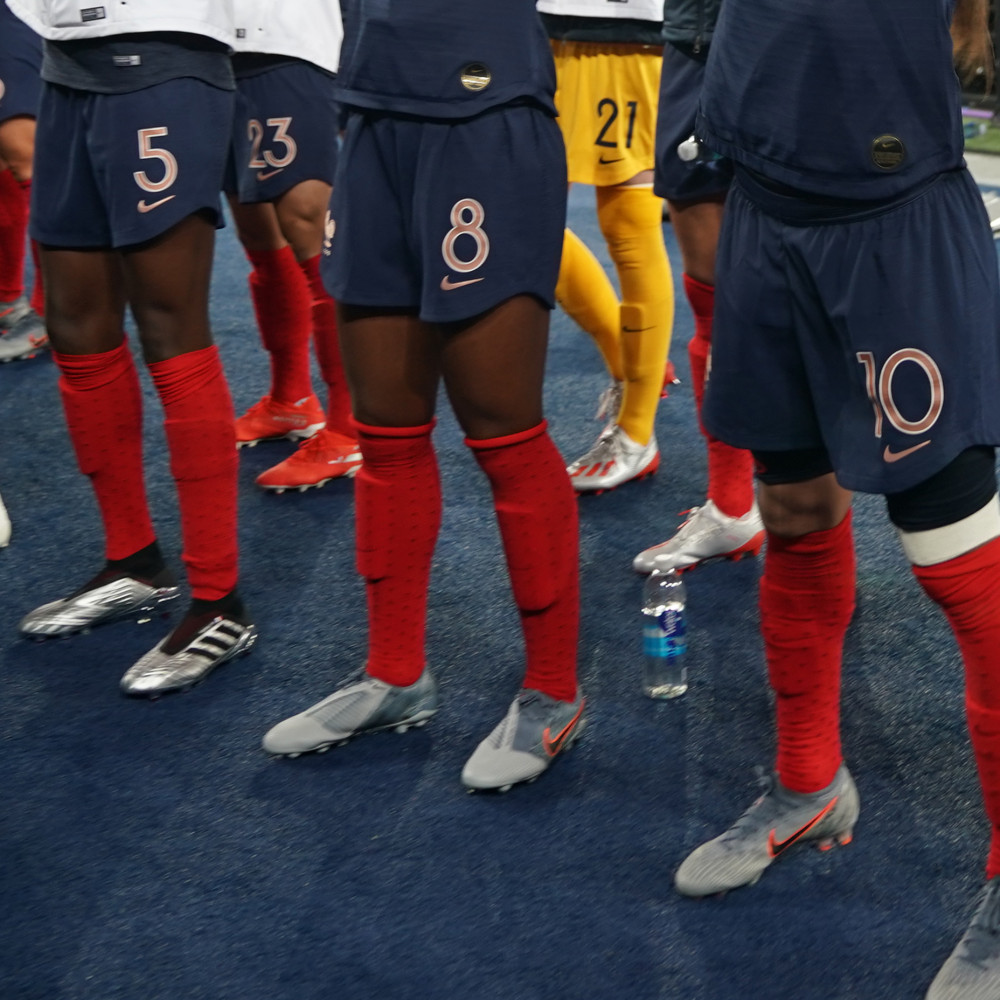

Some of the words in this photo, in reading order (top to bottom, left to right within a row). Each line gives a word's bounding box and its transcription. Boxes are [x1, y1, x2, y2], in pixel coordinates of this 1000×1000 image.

[247, 116, 298, 169] 23
[594, 97, 638, 149] 21
[132, 126, 179, 193] 5
[441, 197, 490, 274] 8
[855, 347, 945, 438] 10
